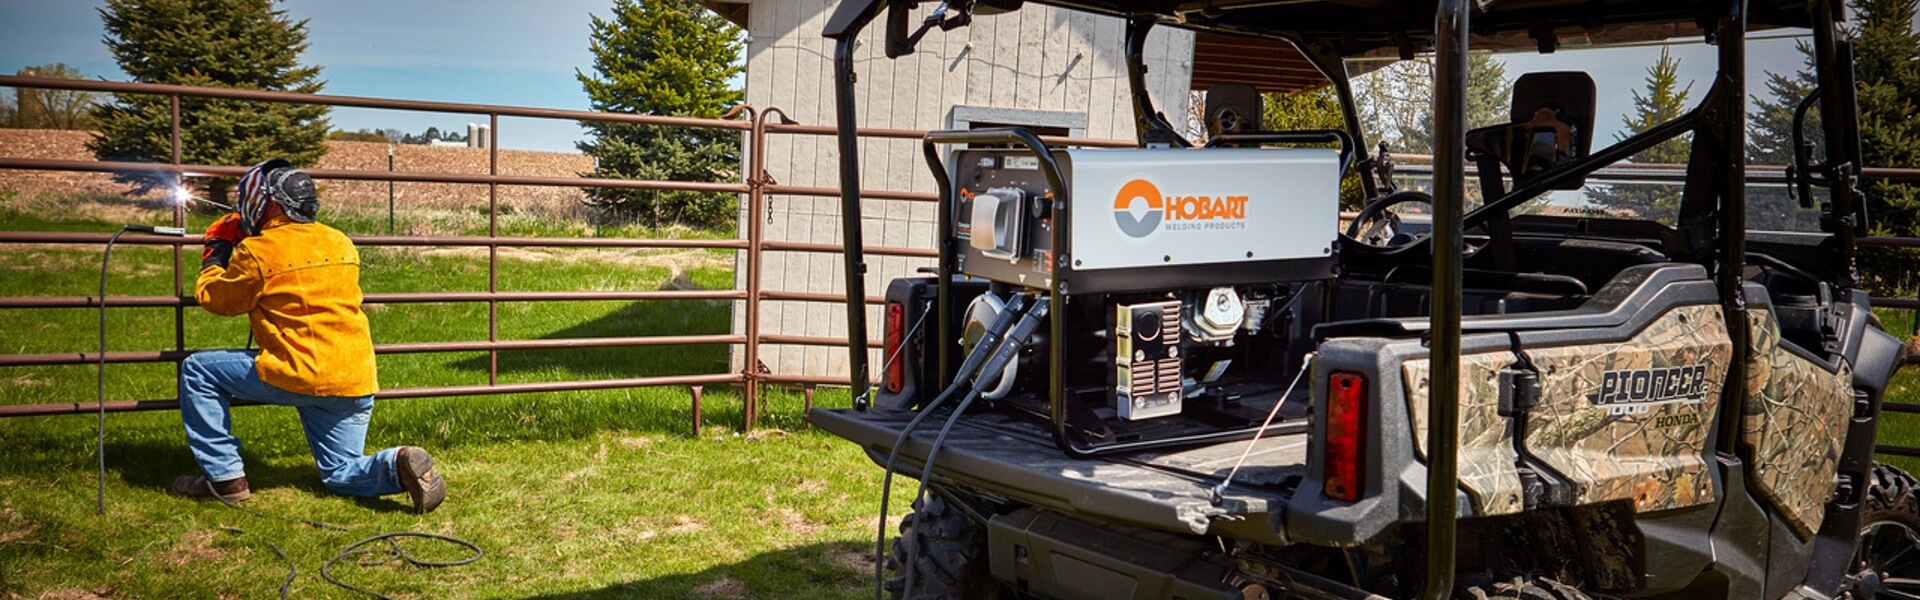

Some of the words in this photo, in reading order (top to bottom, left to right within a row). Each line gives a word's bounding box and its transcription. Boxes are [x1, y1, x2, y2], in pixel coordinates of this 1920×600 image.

[1165, 196, 1248, 220] HOBART
[1165, 223, 1201, 231] WELDING
[1204, 221, 1246, 230] PRODUCTS
[1599, 363, 1706, 404] PIONEER
[1606, 404, 1650, 416] 1000
[1655, 413, 1697, 428] HONDA
